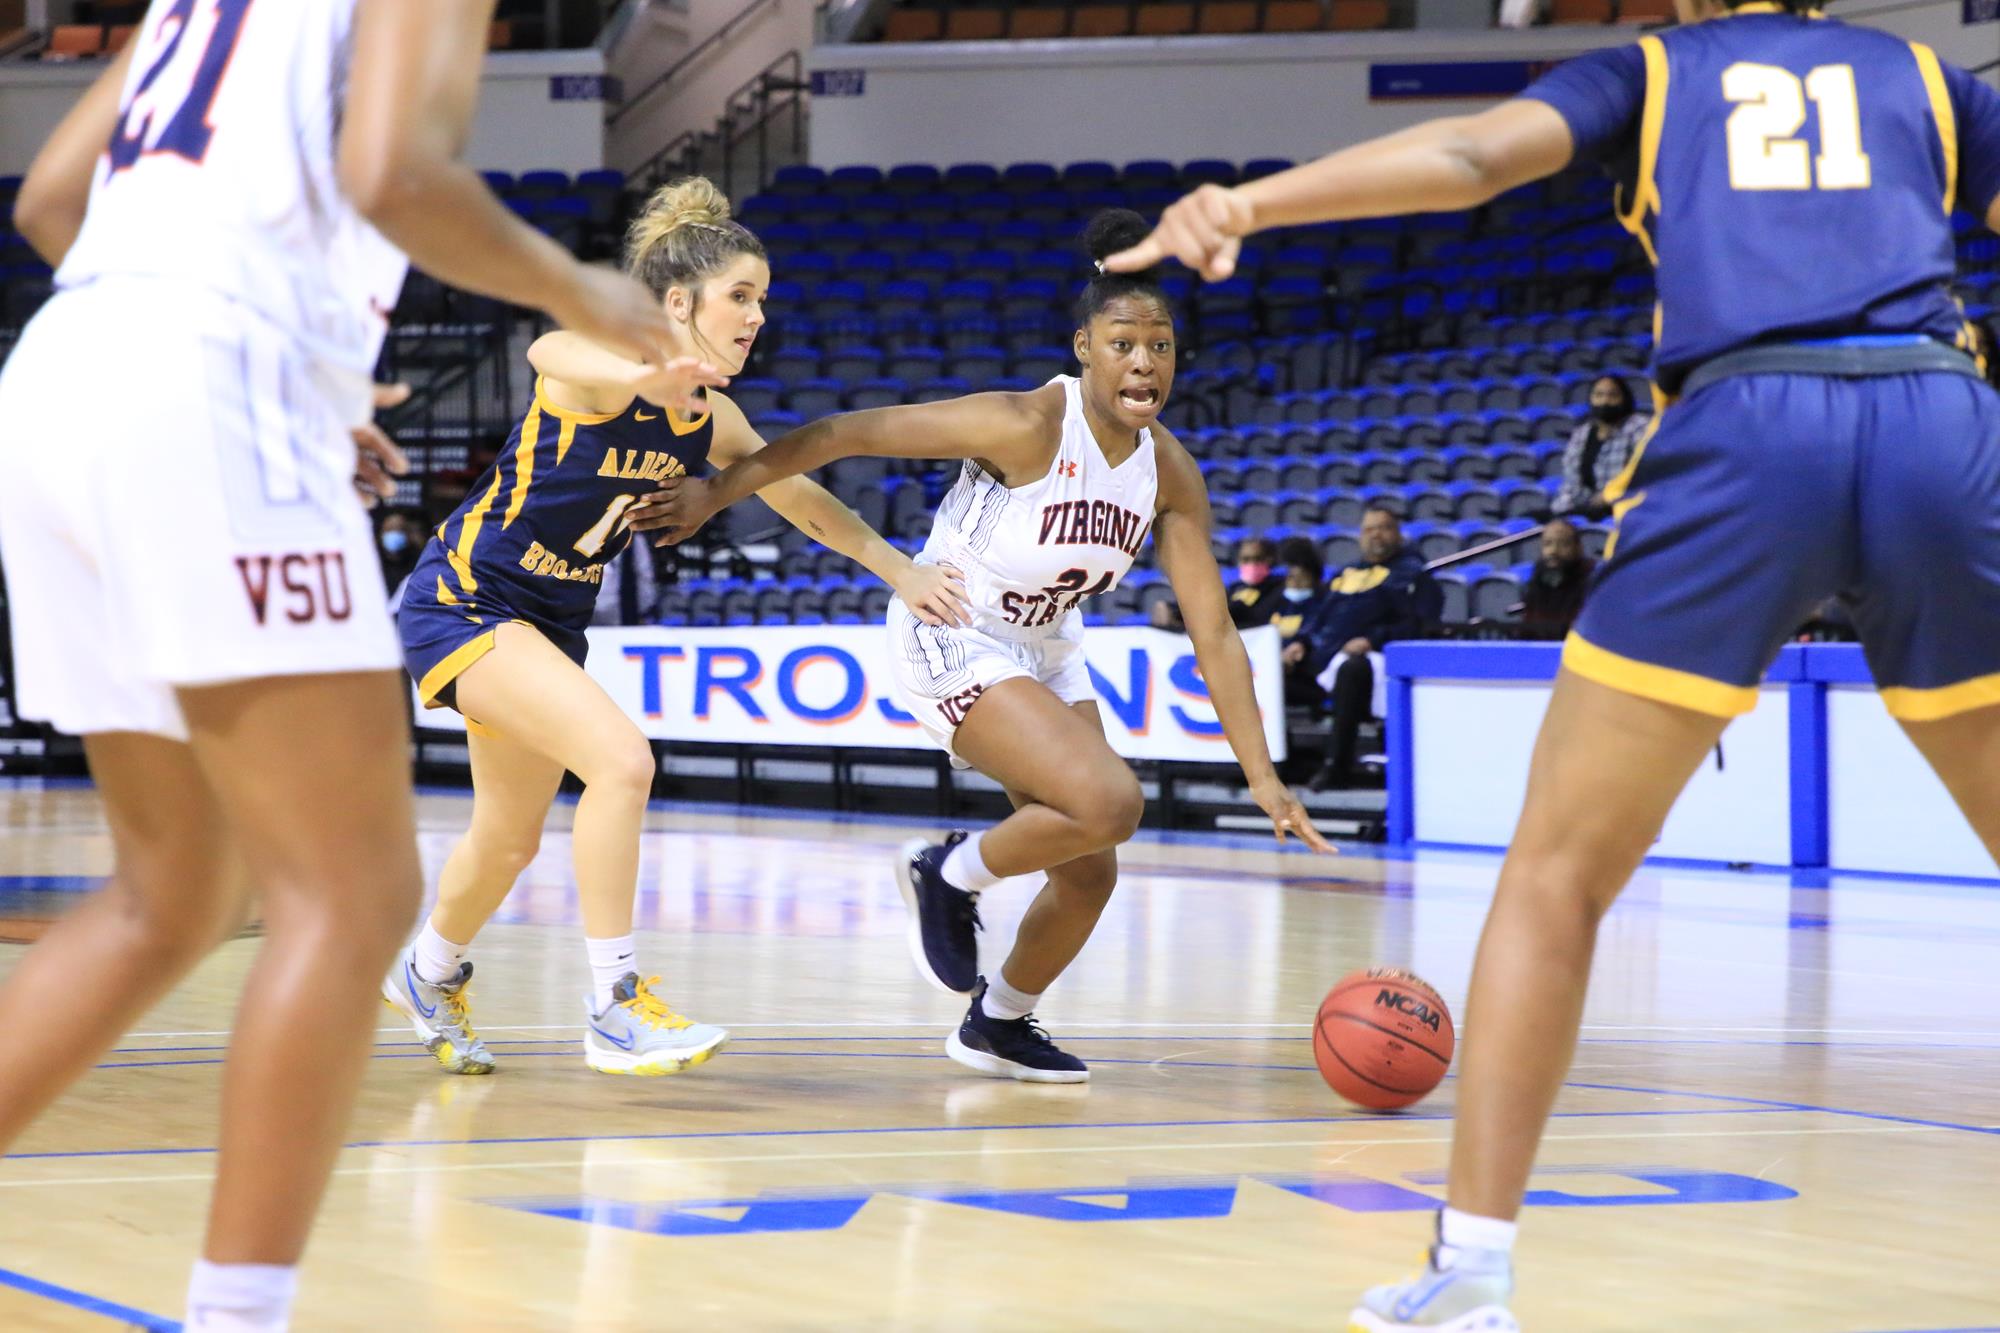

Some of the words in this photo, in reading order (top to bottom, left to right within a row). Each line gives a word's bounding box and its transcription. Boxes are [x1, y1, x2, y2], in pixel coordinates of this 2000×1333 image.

[1721, 61, 1872, 191] 21
[234, 552, 353, 625] VSU
[621, 645, 1262, 740] TRONS
[1375, 987, 1441, 1033] NCAA
